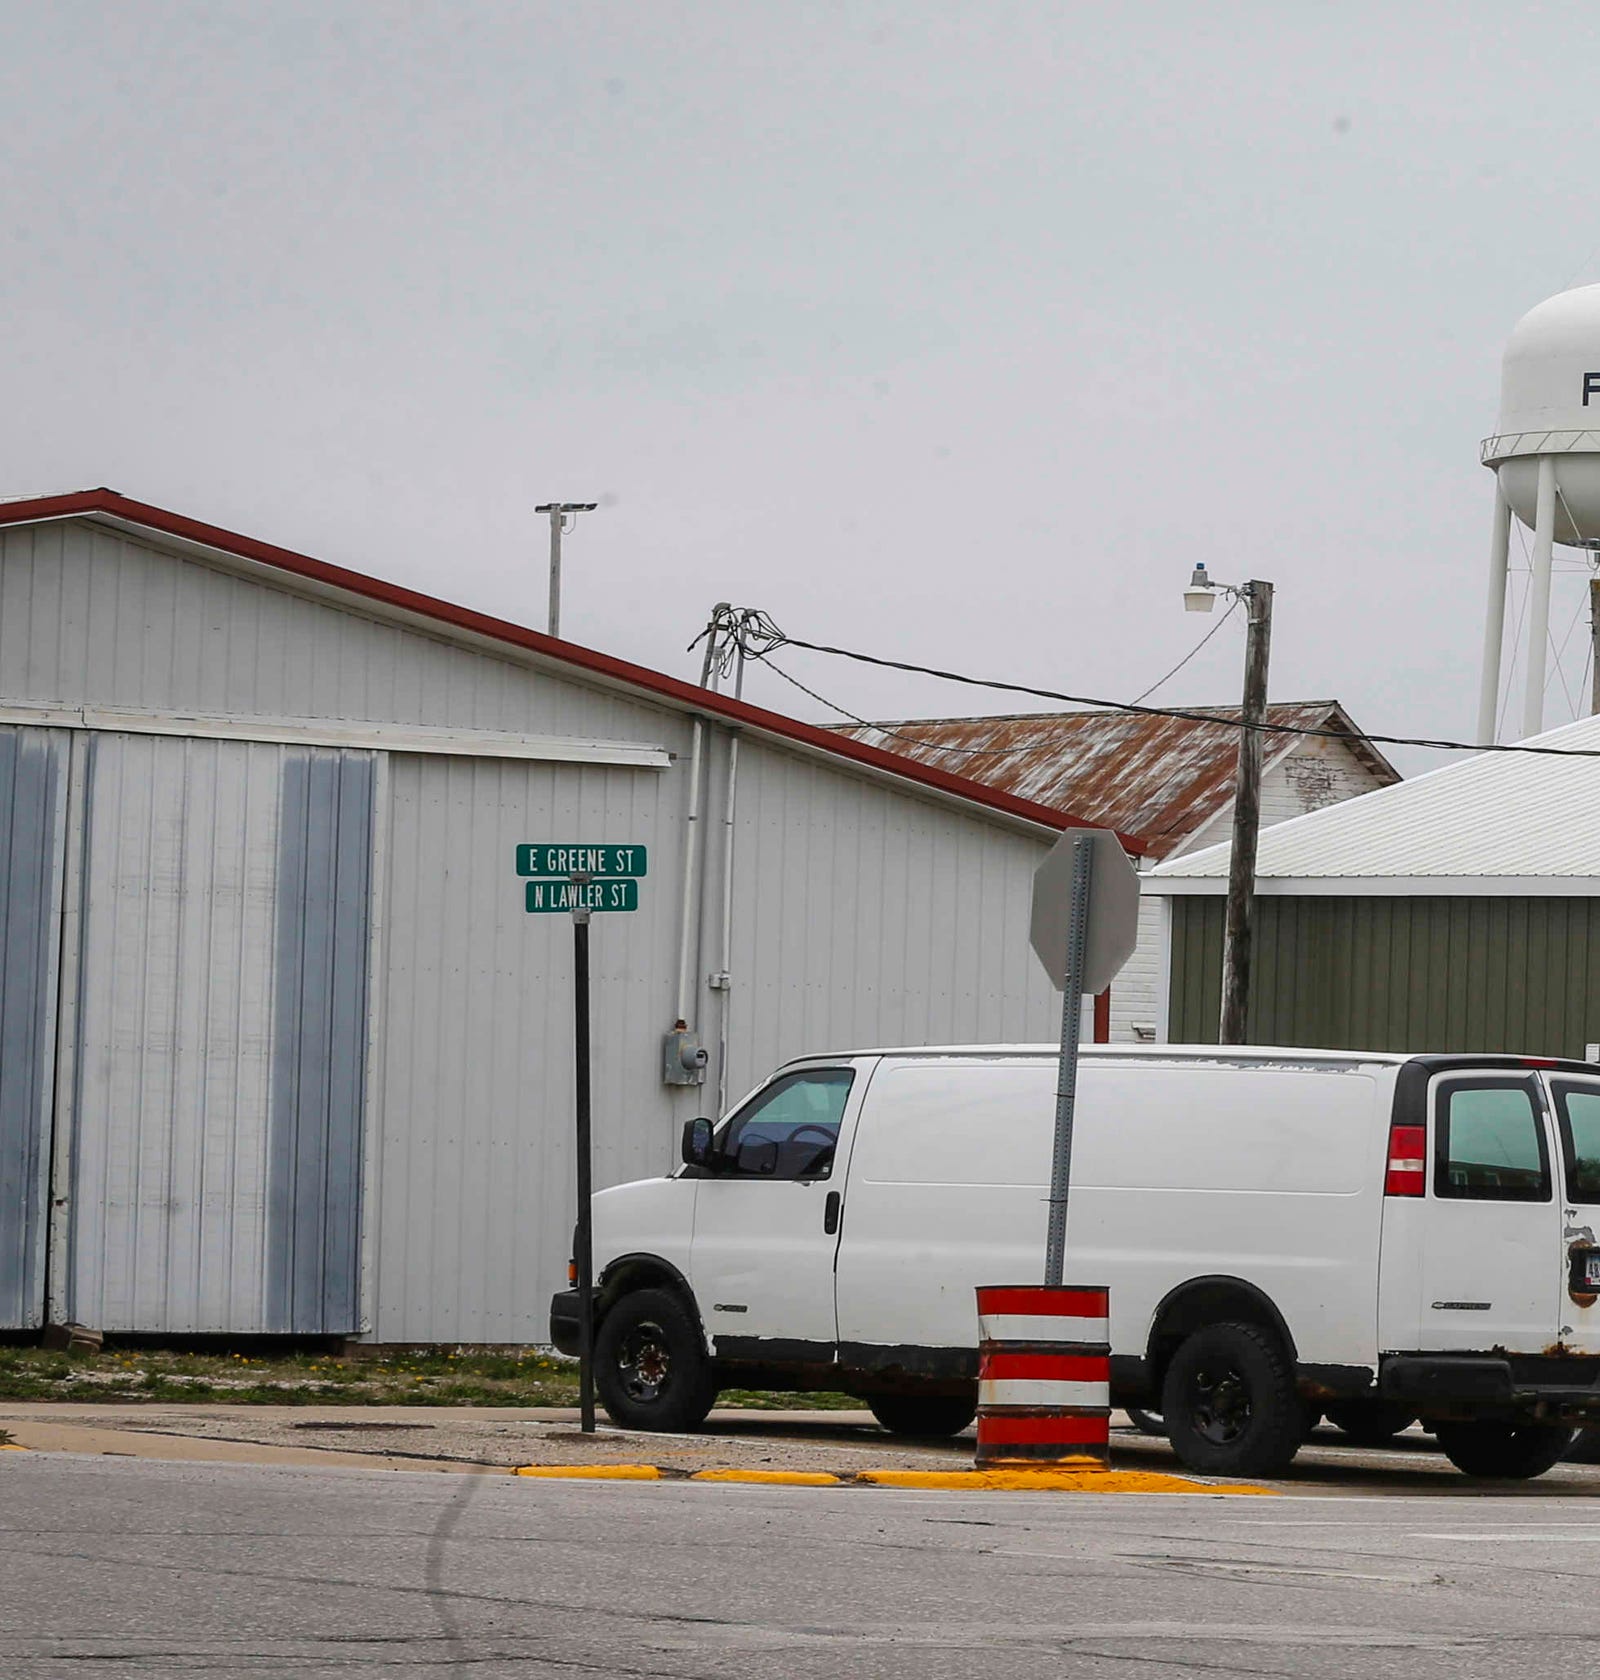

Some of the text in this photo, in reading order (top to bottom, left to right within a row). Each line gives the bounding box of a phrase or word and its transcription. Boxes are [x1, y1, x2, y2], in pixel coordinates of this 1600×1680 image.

[529, 848, 634, 872] E GREENE ST
[535, 884, 627, 908] N LAWLER ST
